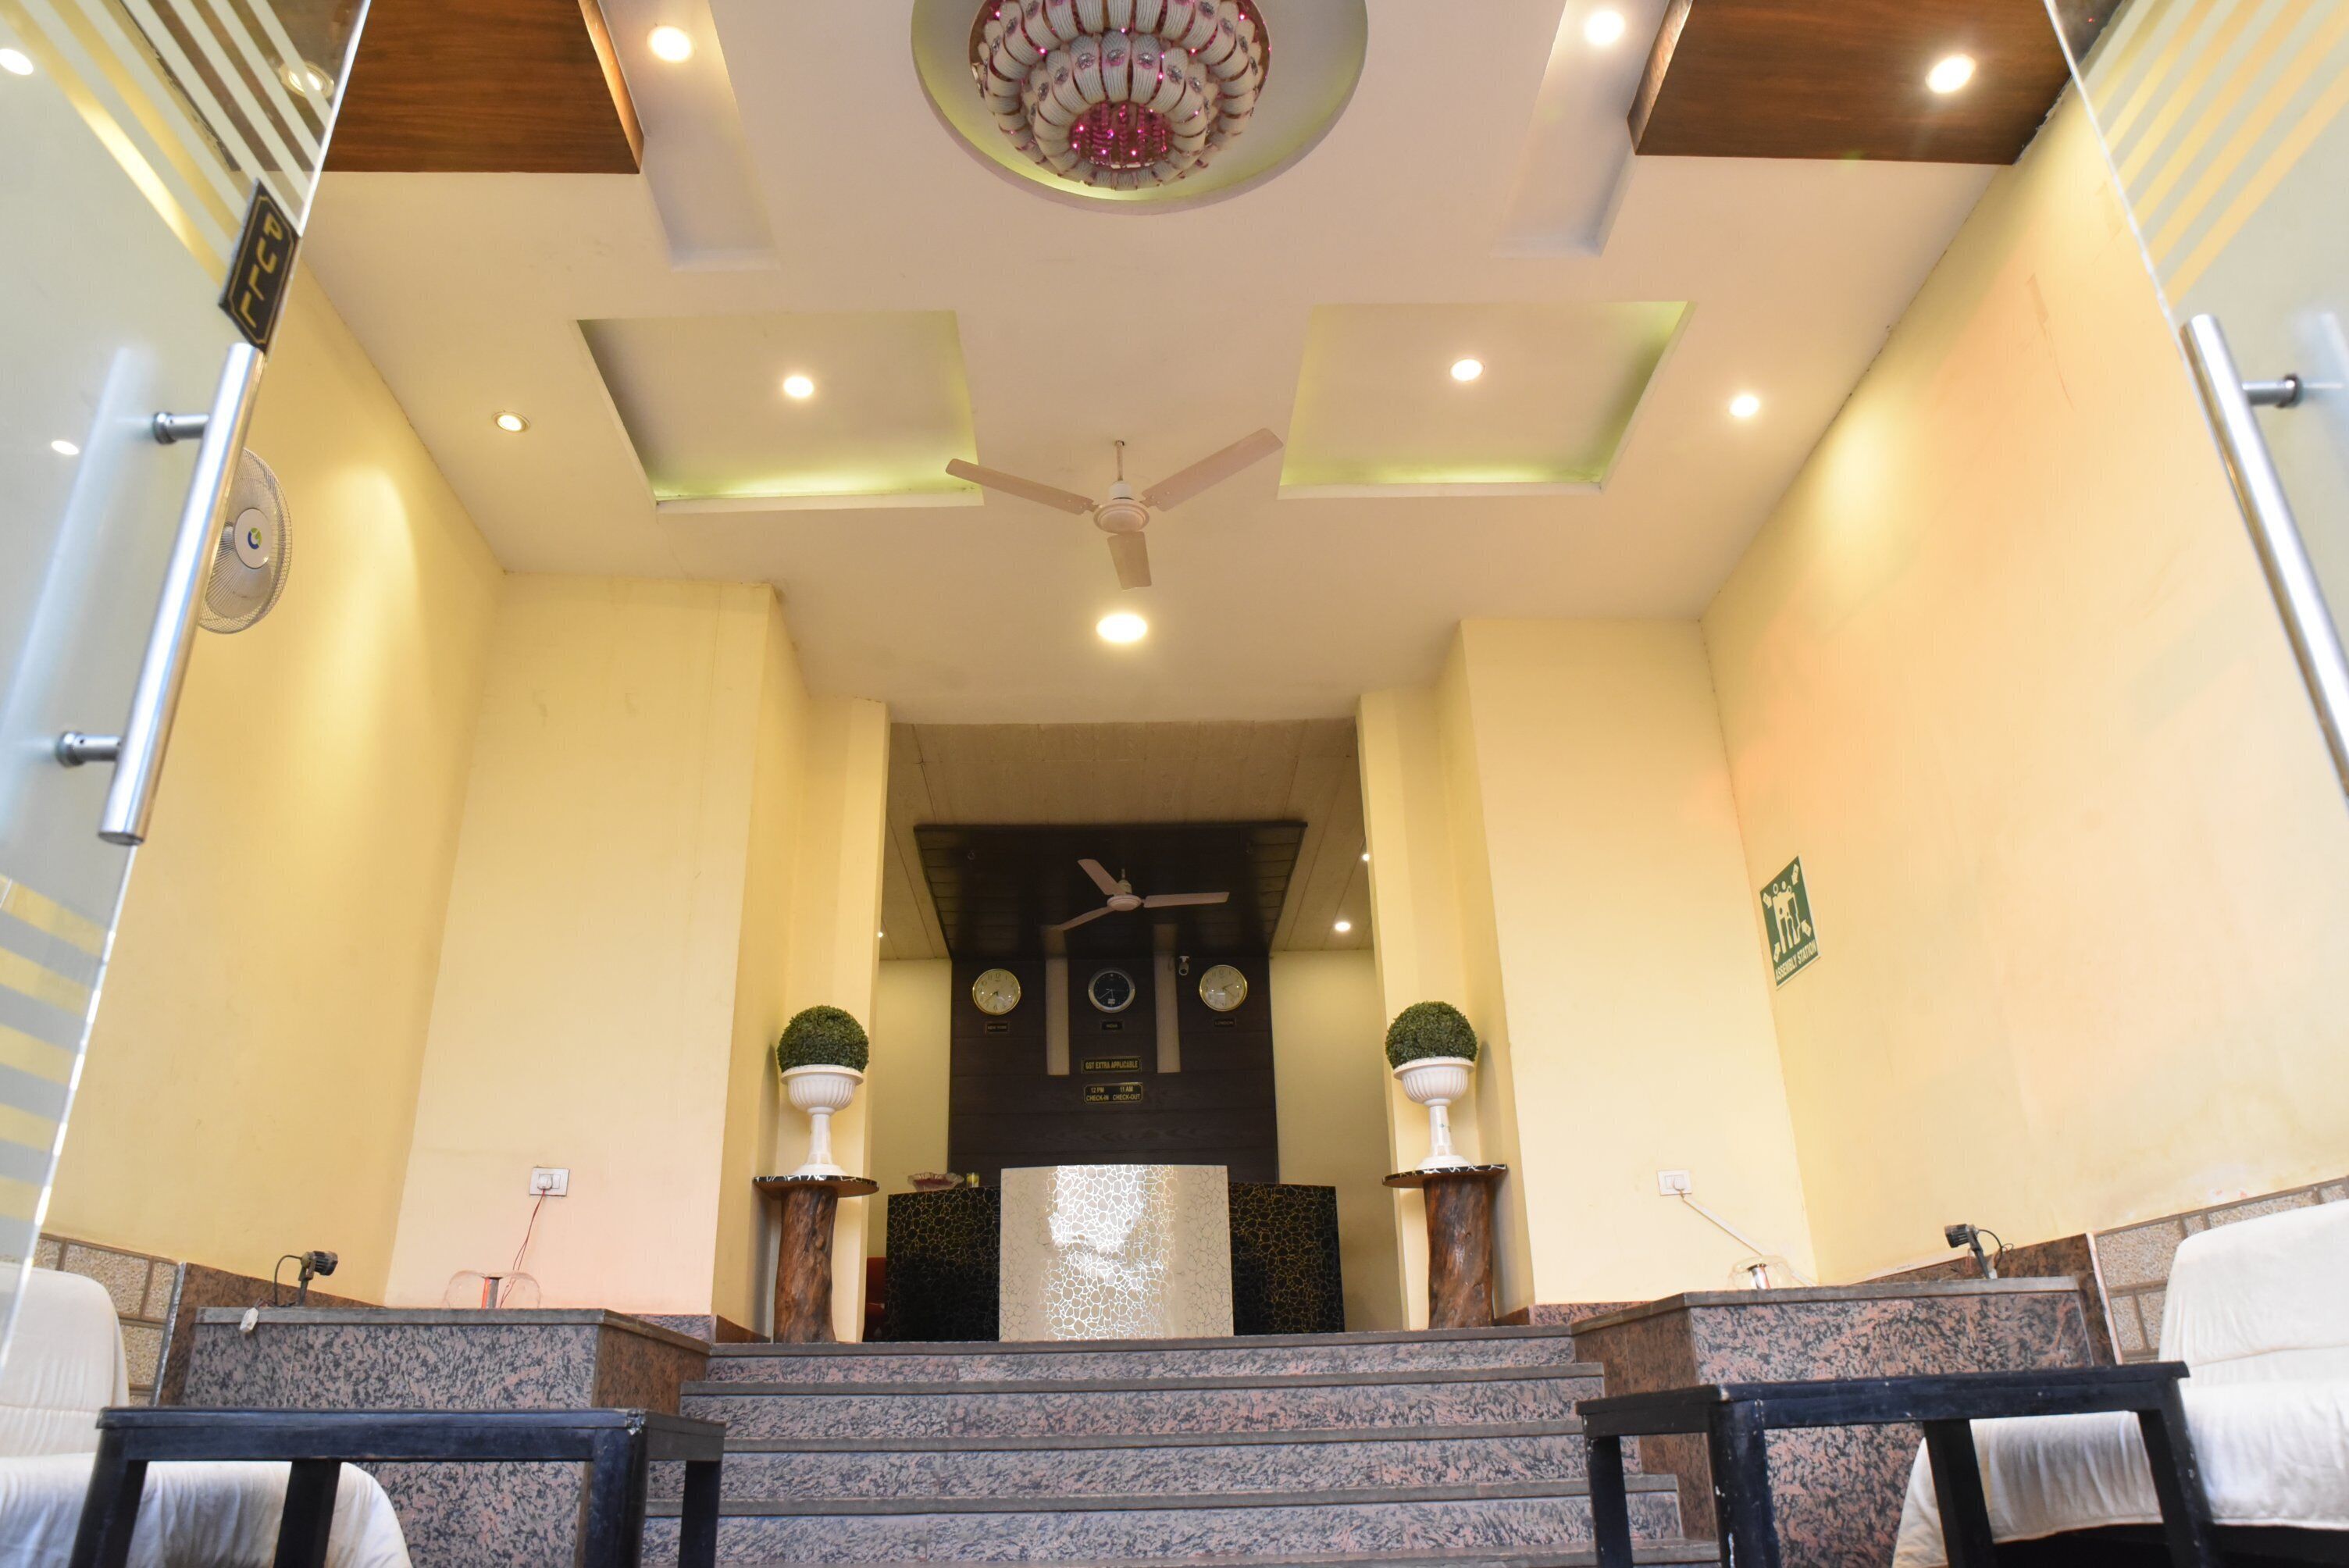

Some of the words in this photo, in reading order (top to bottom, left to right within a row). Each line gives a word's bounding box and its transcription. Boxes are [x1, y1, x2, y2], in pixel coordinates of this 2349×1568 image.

[240, 212, 283, 329] PULL
[1775, 954, 1798, 982] ASSEMBLY
[1797, 939, 1816, 964] STATION
[1085, 1061, 1094, 1070] GST
[1095, 1060, 1110, 1069] EXTRA
